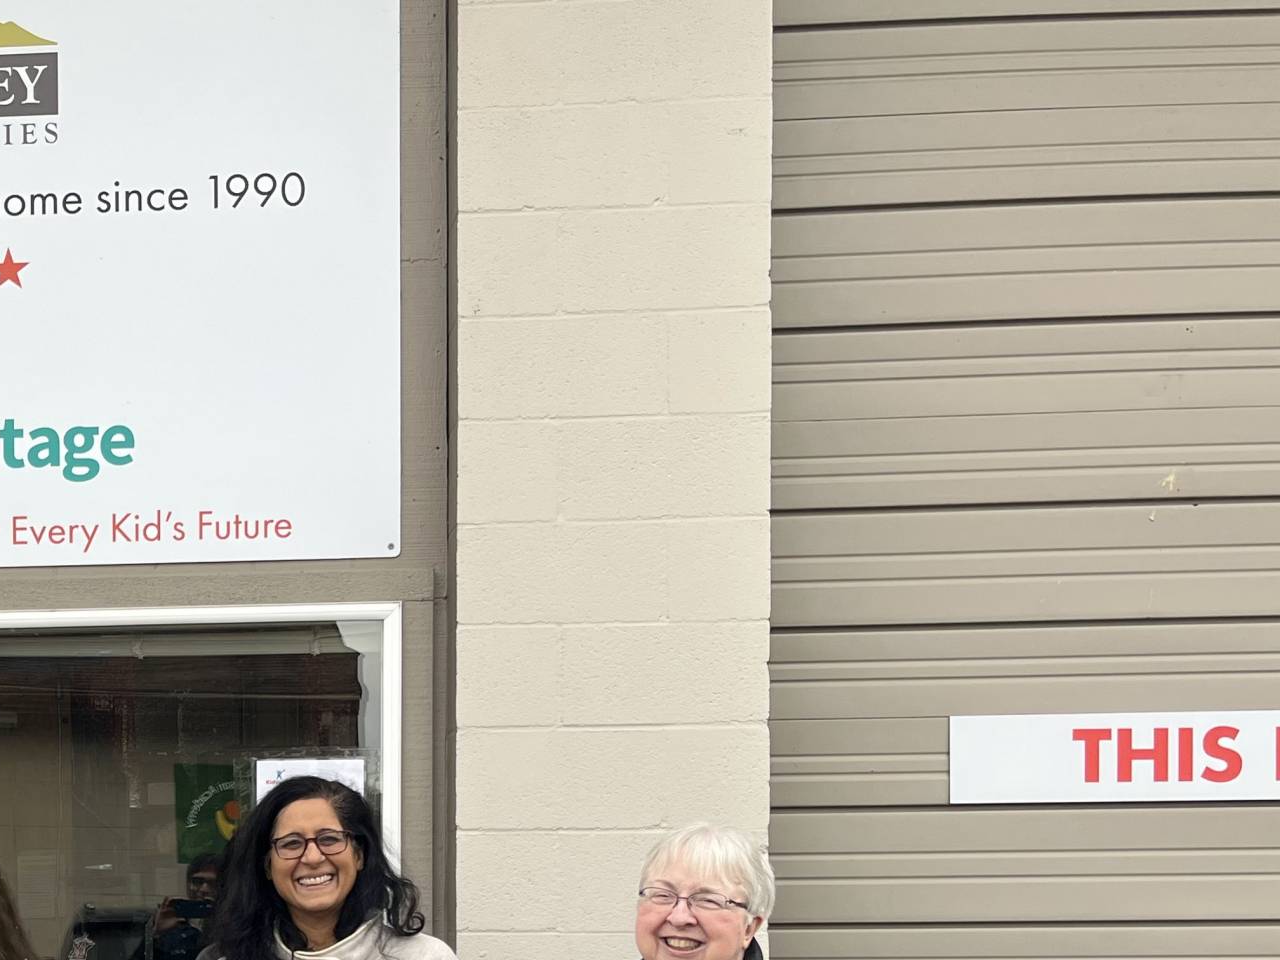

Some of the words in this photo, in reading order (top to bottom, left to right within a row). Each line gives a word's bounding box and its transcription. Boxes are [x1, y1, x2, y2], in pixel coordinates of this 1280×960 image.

[96, 180, 189, 214] since
[208, 171, 306, 209] 1990
[12, 515, 100, 553] Every
[198, 510, 293, 542] Future
[1072, 725, 1243, 783] THIS
